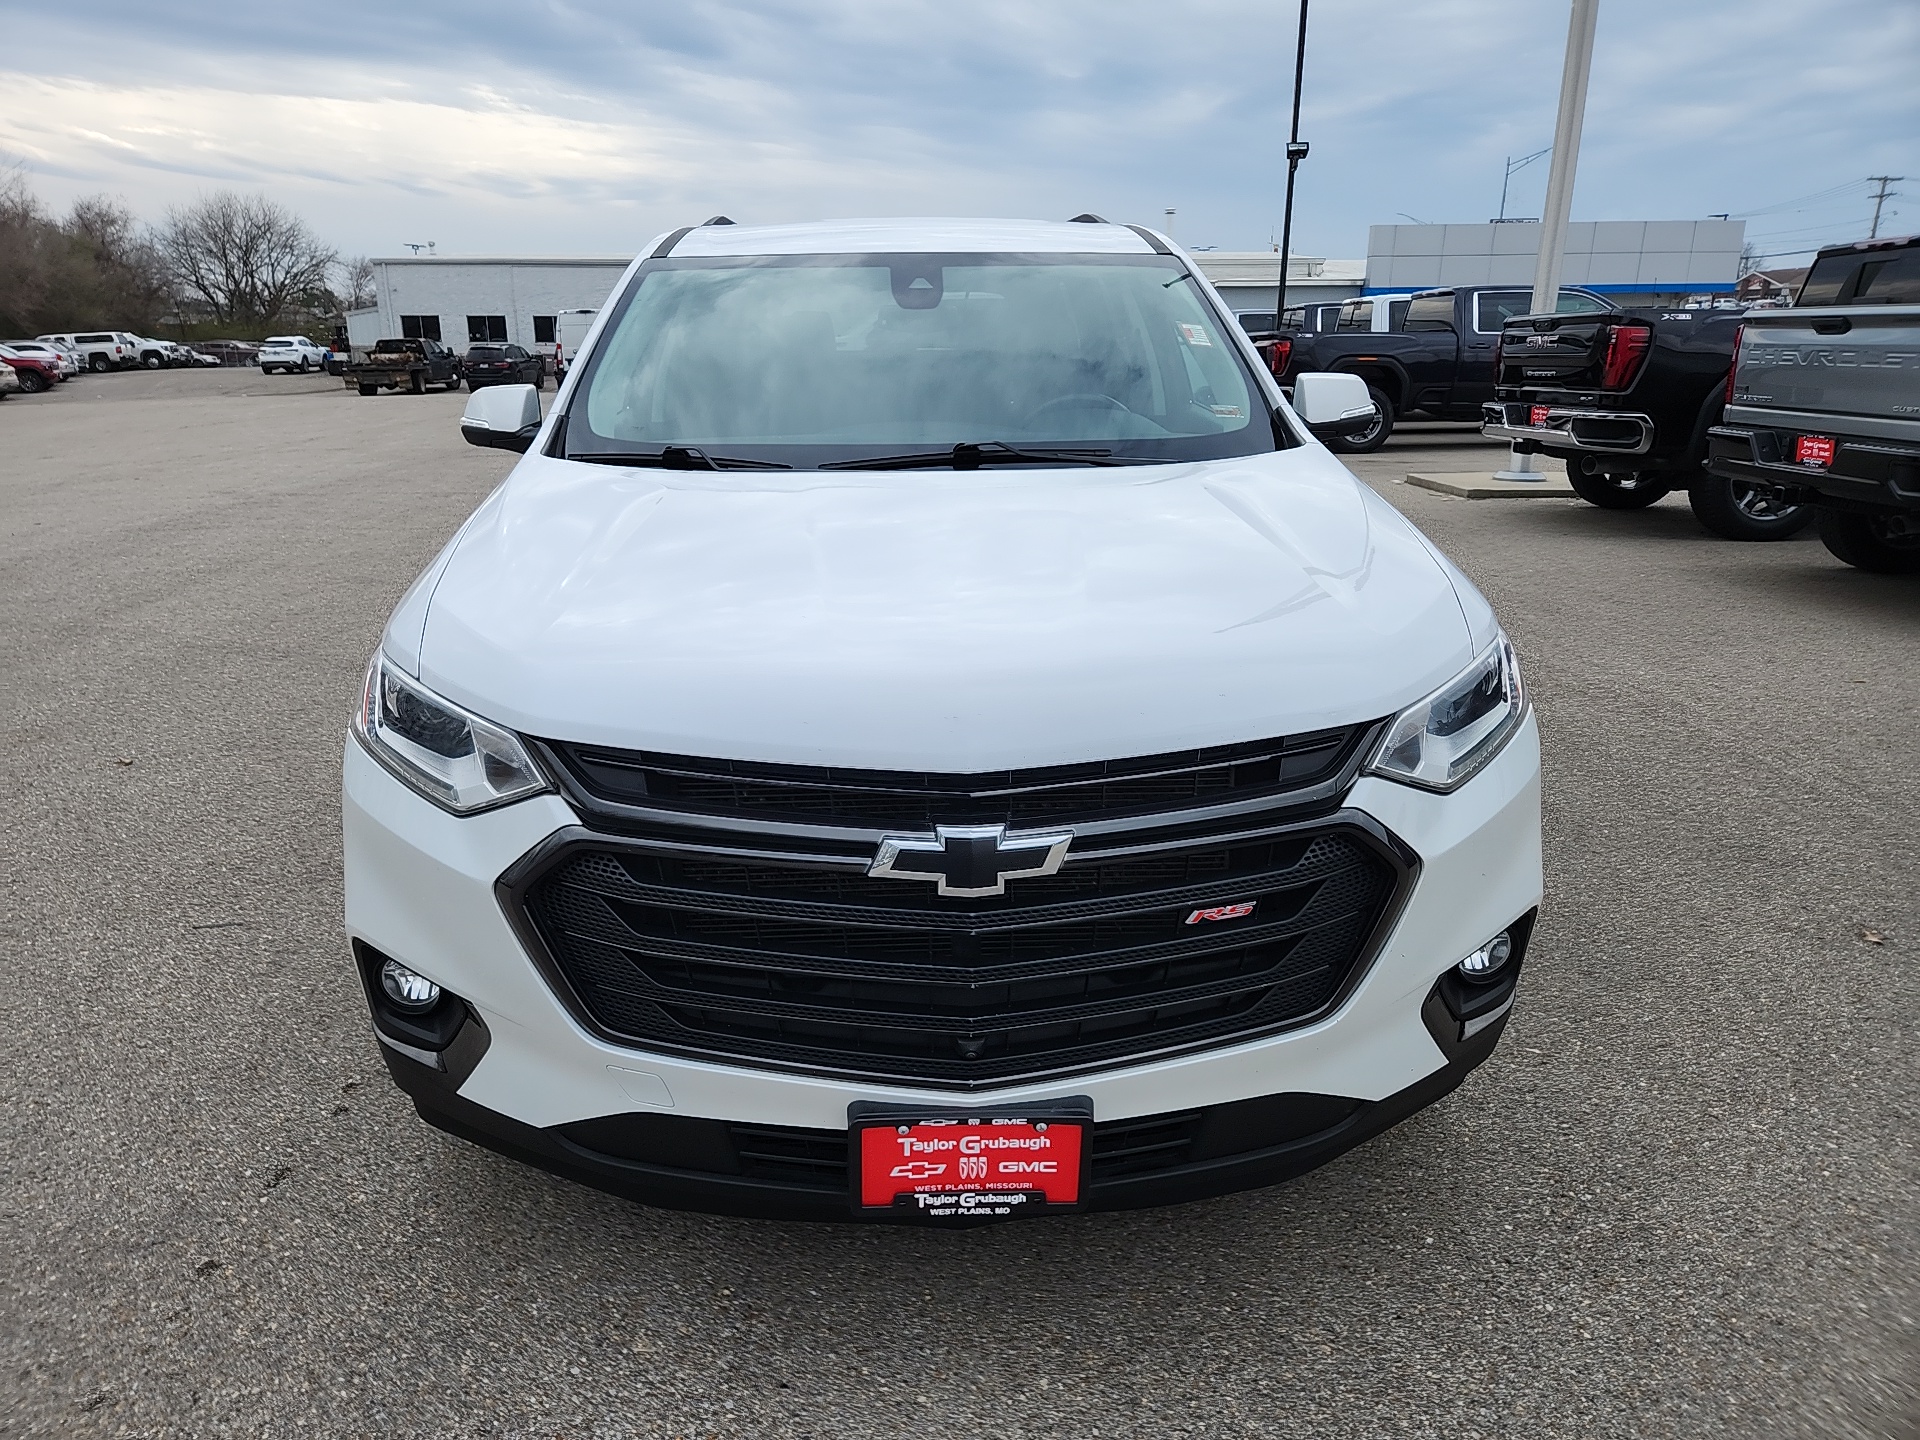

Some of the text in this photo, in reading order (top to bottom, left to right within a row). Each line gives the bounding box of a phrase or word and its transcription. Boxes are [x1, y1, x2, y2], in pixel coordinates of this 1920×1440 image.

[1526, 335, 1560, 349] GMC
[1184, 900, 1257, 925] RS
[992, 1118, 1028, 1126] GMC
[897, 1135, 1051, 1157] Taylor Grubaugh
[998, 1161, 1058, 1173] GMC
[914, 1182, 1033, 1192] WEST PLAINS, MISSOURI
[913, 1192, 1027, 1208] Taylor Grubaugh
[929, 1206, 1011, 1216] WEST PLAINS, MO
